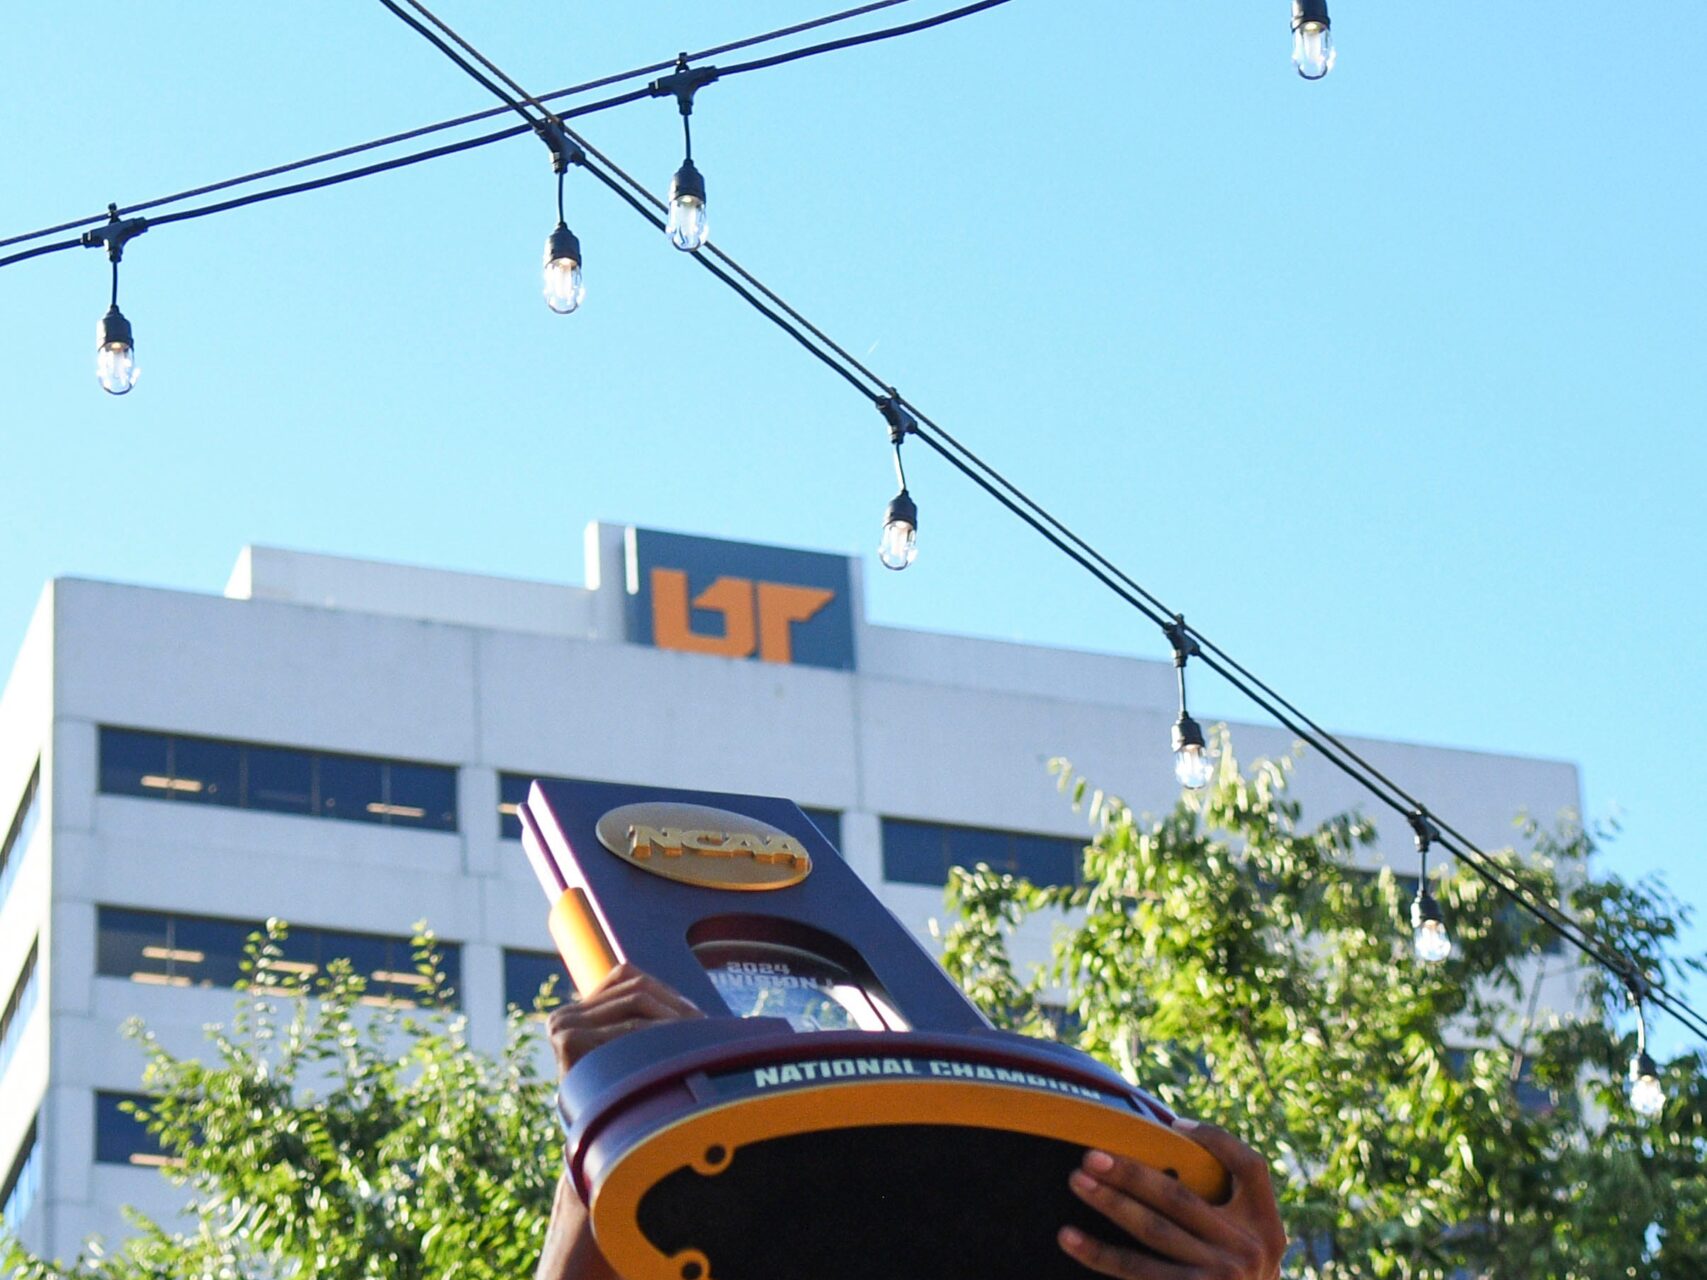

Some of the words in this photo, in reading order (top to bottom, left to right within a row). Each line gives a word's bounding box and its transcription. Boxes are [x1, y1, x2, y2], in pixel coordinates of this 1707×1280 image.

[626, 824, 809, 871] NCAA
[726, 961, 791, 975] 2024
[754, 1057, 921, 1088] NATIONAL
